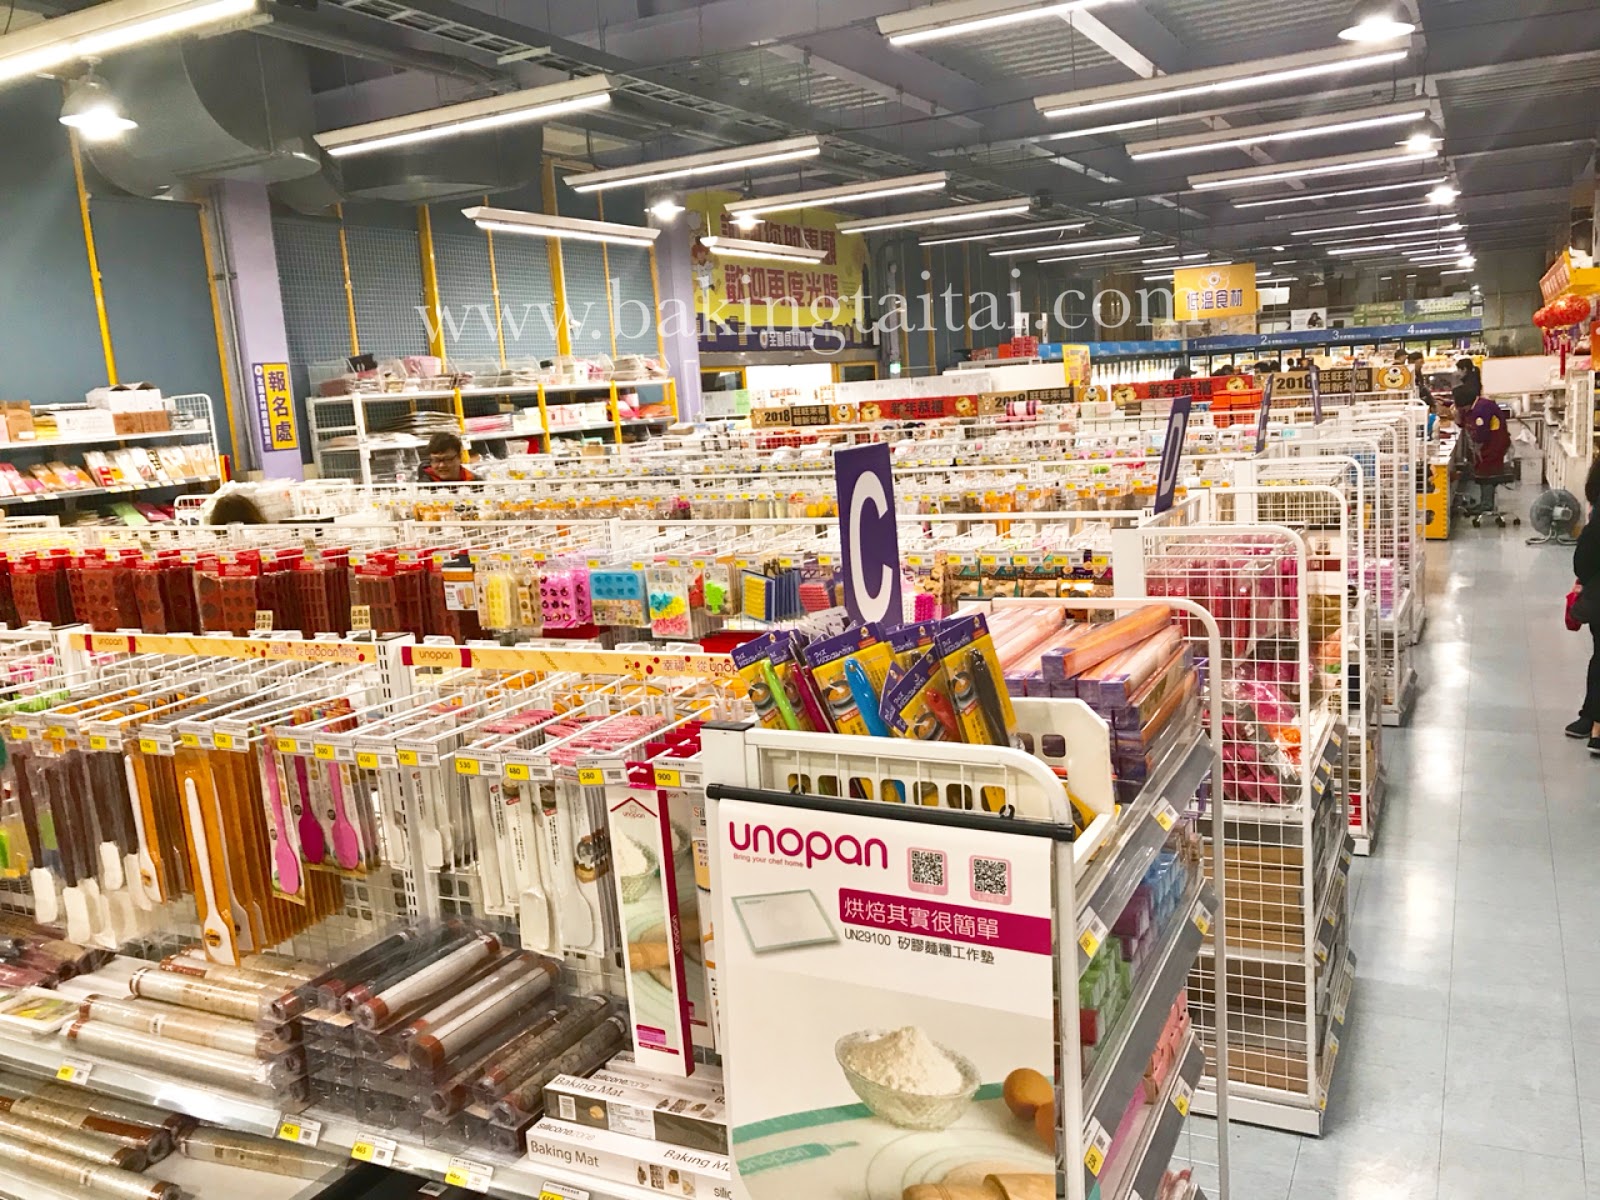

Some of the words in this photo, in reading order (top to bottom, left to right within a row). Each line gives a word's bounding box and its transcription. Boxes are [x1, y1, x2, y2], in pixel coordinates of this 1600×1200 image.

[724, 264, 839, 308] 歡迎再度光臨
[1187, 289, 1243, 311] 低溫食材
[1260, 334, 1268, 345] 2
[1331, 329, 1340, 340] 3
[1406, 324, 1415, 335] 4
[1276, 373, 1311, 390] 2018
[268, 371, 293, 442] 報名處
[764, 409, 791, 422] 2018
[849, 470, 893, 622] C
[418, 649, 454, 661] unopan
[729, 821, 888, 869] unopan
[733, 852, 750, 863] Bring
[752, 855, 767, 864] your
[768, 856, 783, 866] chef
[784, 859, 804, 868] home
[844, 896, 1000, 941] 烘焙其實很簡單
[844, 928, 891, 946] UN29100
[553, 1076, 597, 1093] Baking
[597, 1083, 625, 1098] Mat
[530, 1139, 572, 1165] Baking
[574, 1150, 600, 1168] Mat
[663, 1149, 711, 1169] Baking
